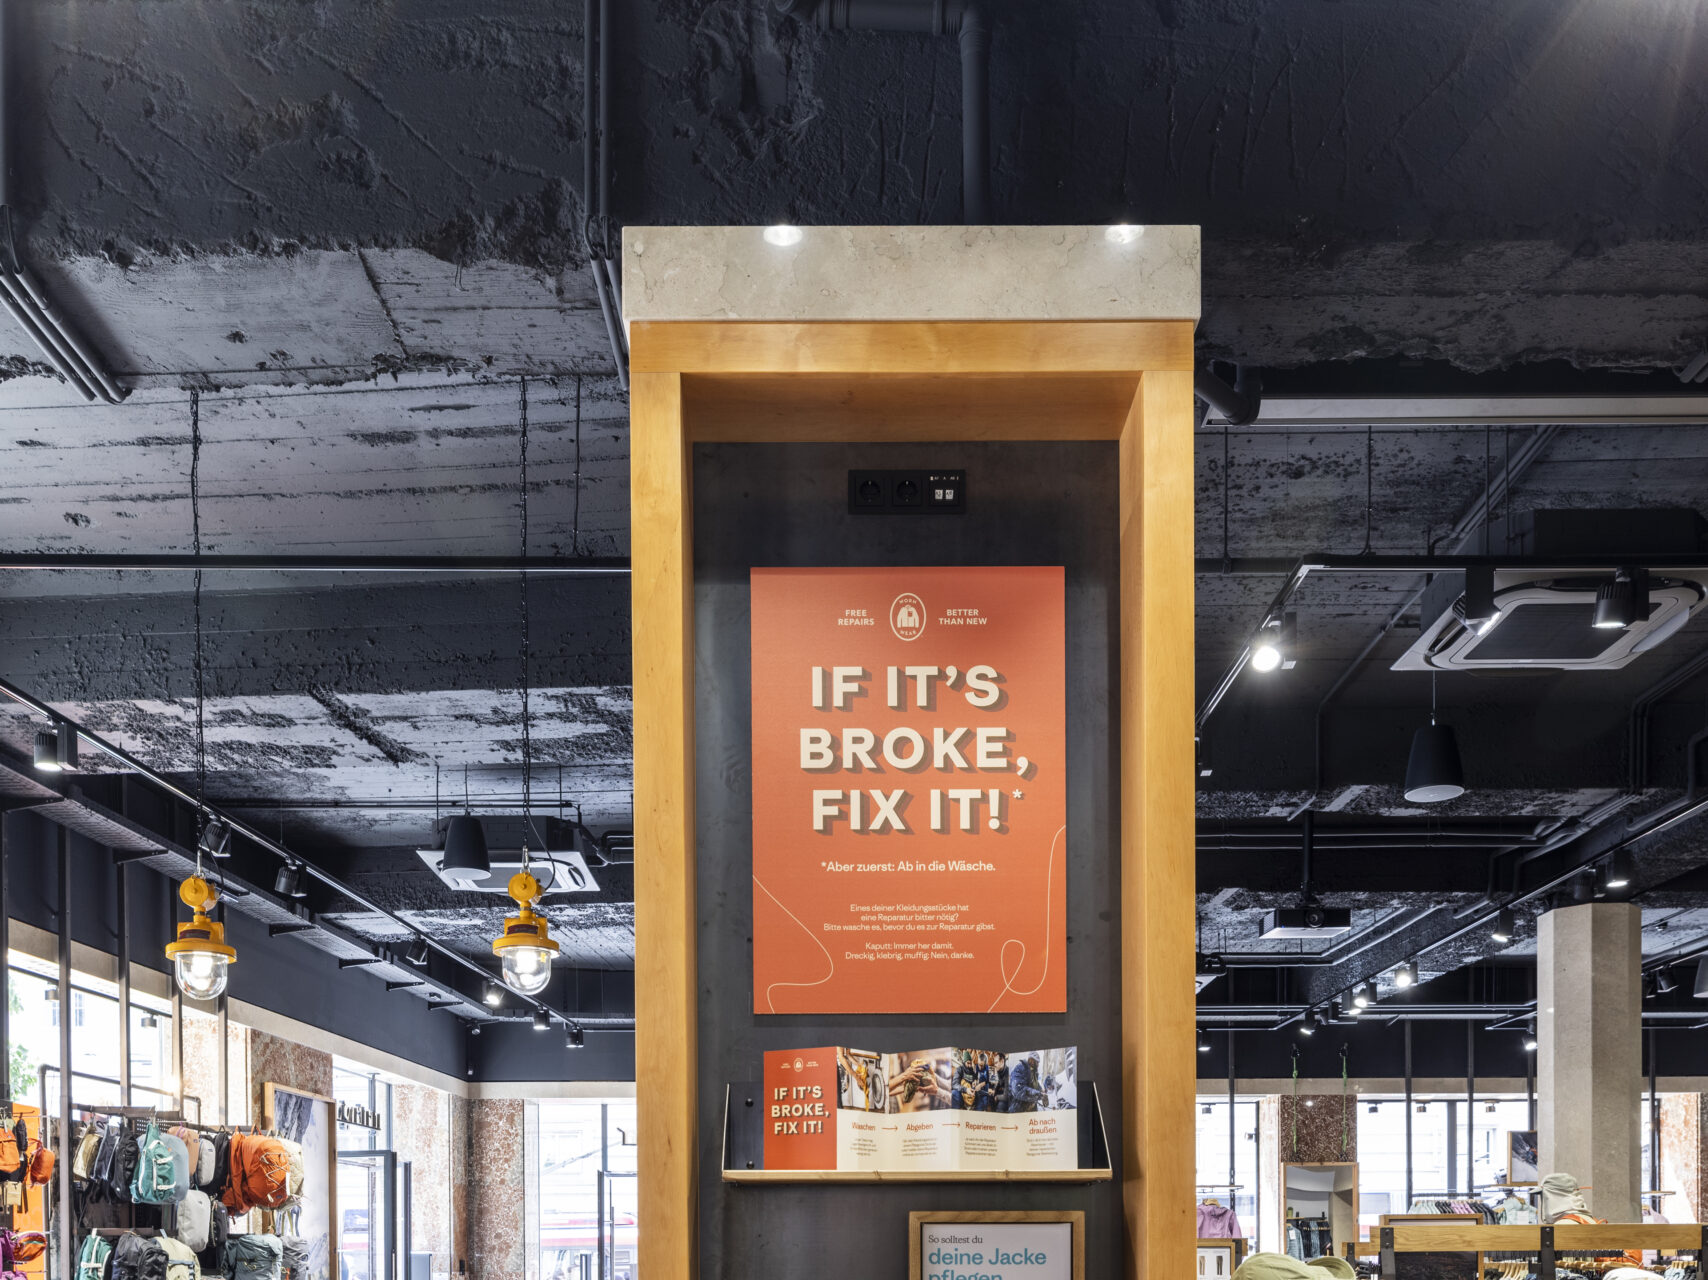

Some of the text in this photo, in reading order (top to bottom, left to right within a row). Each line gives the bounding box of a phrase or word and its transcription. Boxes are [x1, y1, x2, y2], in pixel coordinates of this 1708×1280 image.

[845, 609, 867, 617] FREE
[946, 608, 979, 617] BETTER
[838, 618, 875, 626] REPAIRS
[938, 617, 988, 625] THAN NEW
[812, 664, 1000, 707] IF IT’S
[800, 726, 1029, 777] BROKE,
[812, 789, 905, 830] FIX
[856, 861, 895, 872] zuerst:
[897, 861, 914, 872] Ab
[915, 861, 926, 871] in
[928, 860, 946, 871] die
[948, 860, 996, 872] Wäsche.
[850, 904, 969, 914] Eines deiner Kleidungsstücke hat
[861, 913, 959, 924] eine Reparatur bitter nötig?
[823, 923, 842, 931] Bitte
[883, 923, 905, 931] bevor
[905, 923, 916, 931] du
[939, 923, 975, 932] Reparatur
[976, 923, 996, 932] gibst.
[865, 942, 954, 951] Kaputt: Immer her damit.
[845, 952, 876, 961] Dreckig,
[876, 952, 903, 961] klebrig,
[930, 952, 950, 960] Nein,
[950, 952, 975, 960] danke.
[774, 1085, 822, 1100] IF IT’S
[771, 1102, 830, 1118] BROKE,
[852, 1121, 876, 1131] Waschen
[965, 1121, 997, 1132] Reparieren
[1028, 1117, 1056, 1126] Ab nach
[774, 1120, 822, 1135] FIX IT!
[906, 1123, 934, 1133] Abgeben
[1029, 1126, 1057, 1135] draußen
[928, 1234, 983, 1244] So solltest du
[928, 1248, 1047, 1266] deine Jacke
